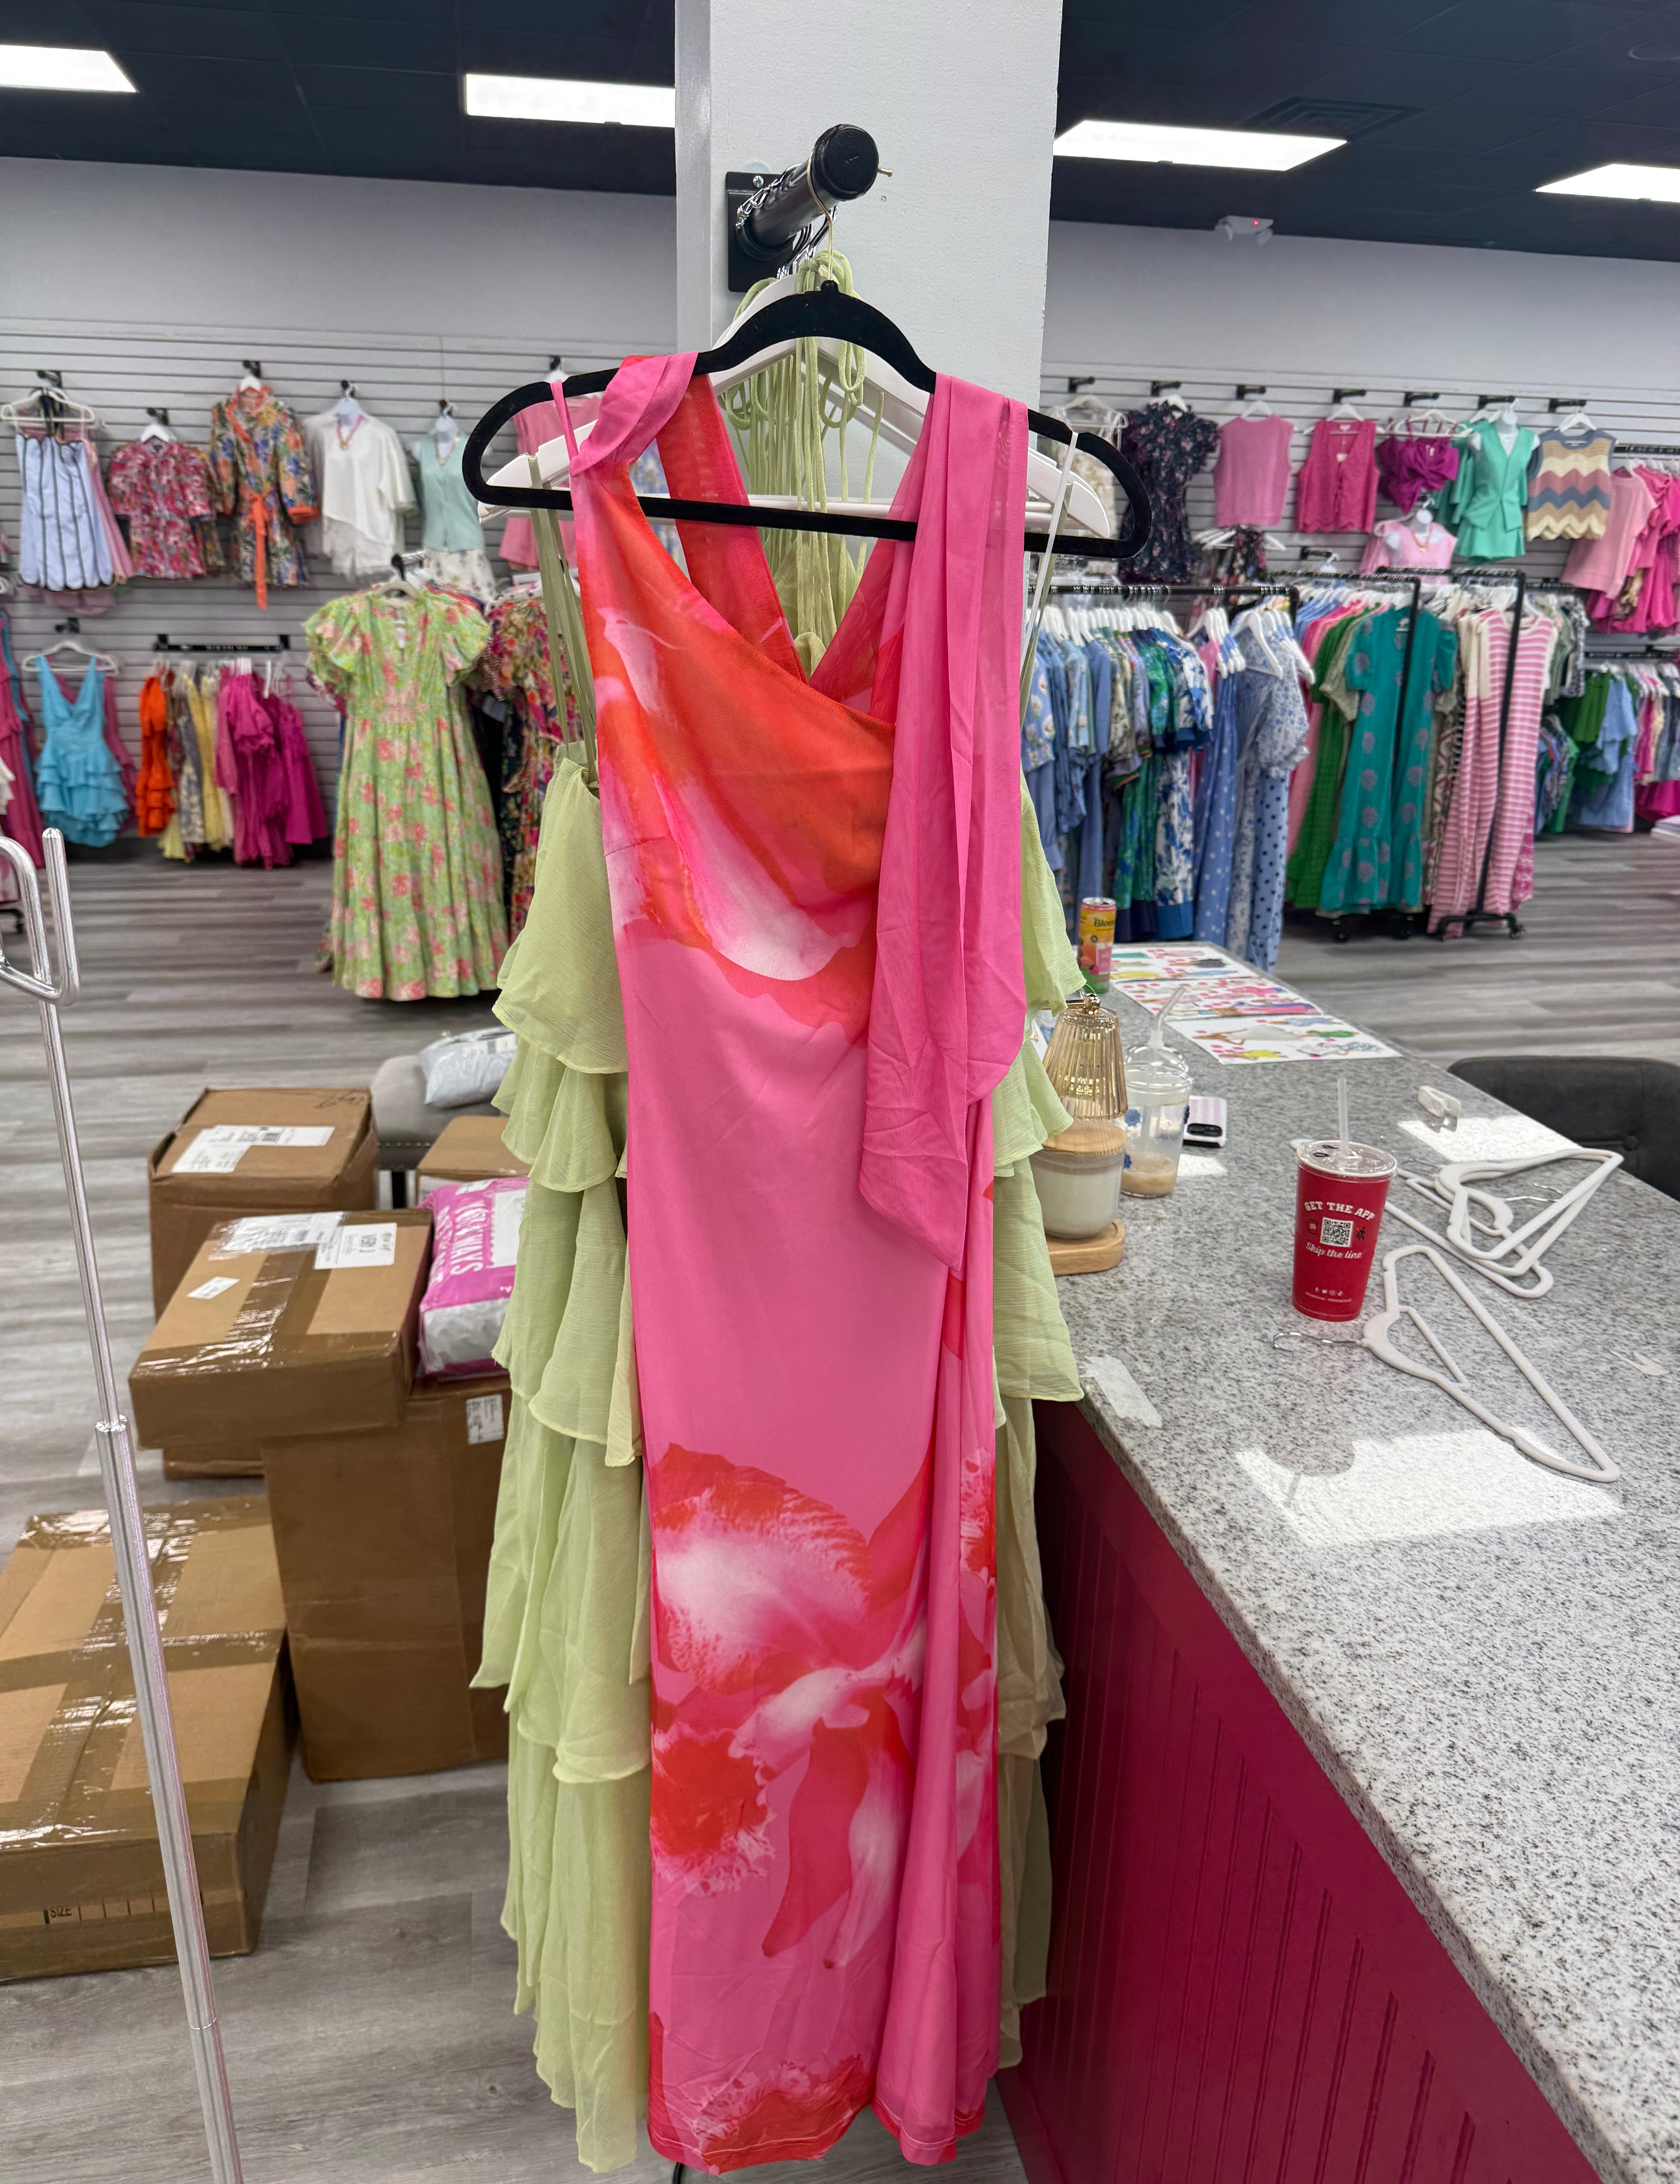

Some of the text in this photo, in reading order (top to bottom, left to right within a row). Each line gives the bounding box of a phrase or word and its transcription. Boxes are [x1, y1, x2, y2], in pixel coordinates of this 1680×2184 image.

[1304, 1201, 1375, 1220] GET THE APP
[1305, 1242, 1362, 1259] Skip the line
[50, 1907, 72, 1918] SIZE
